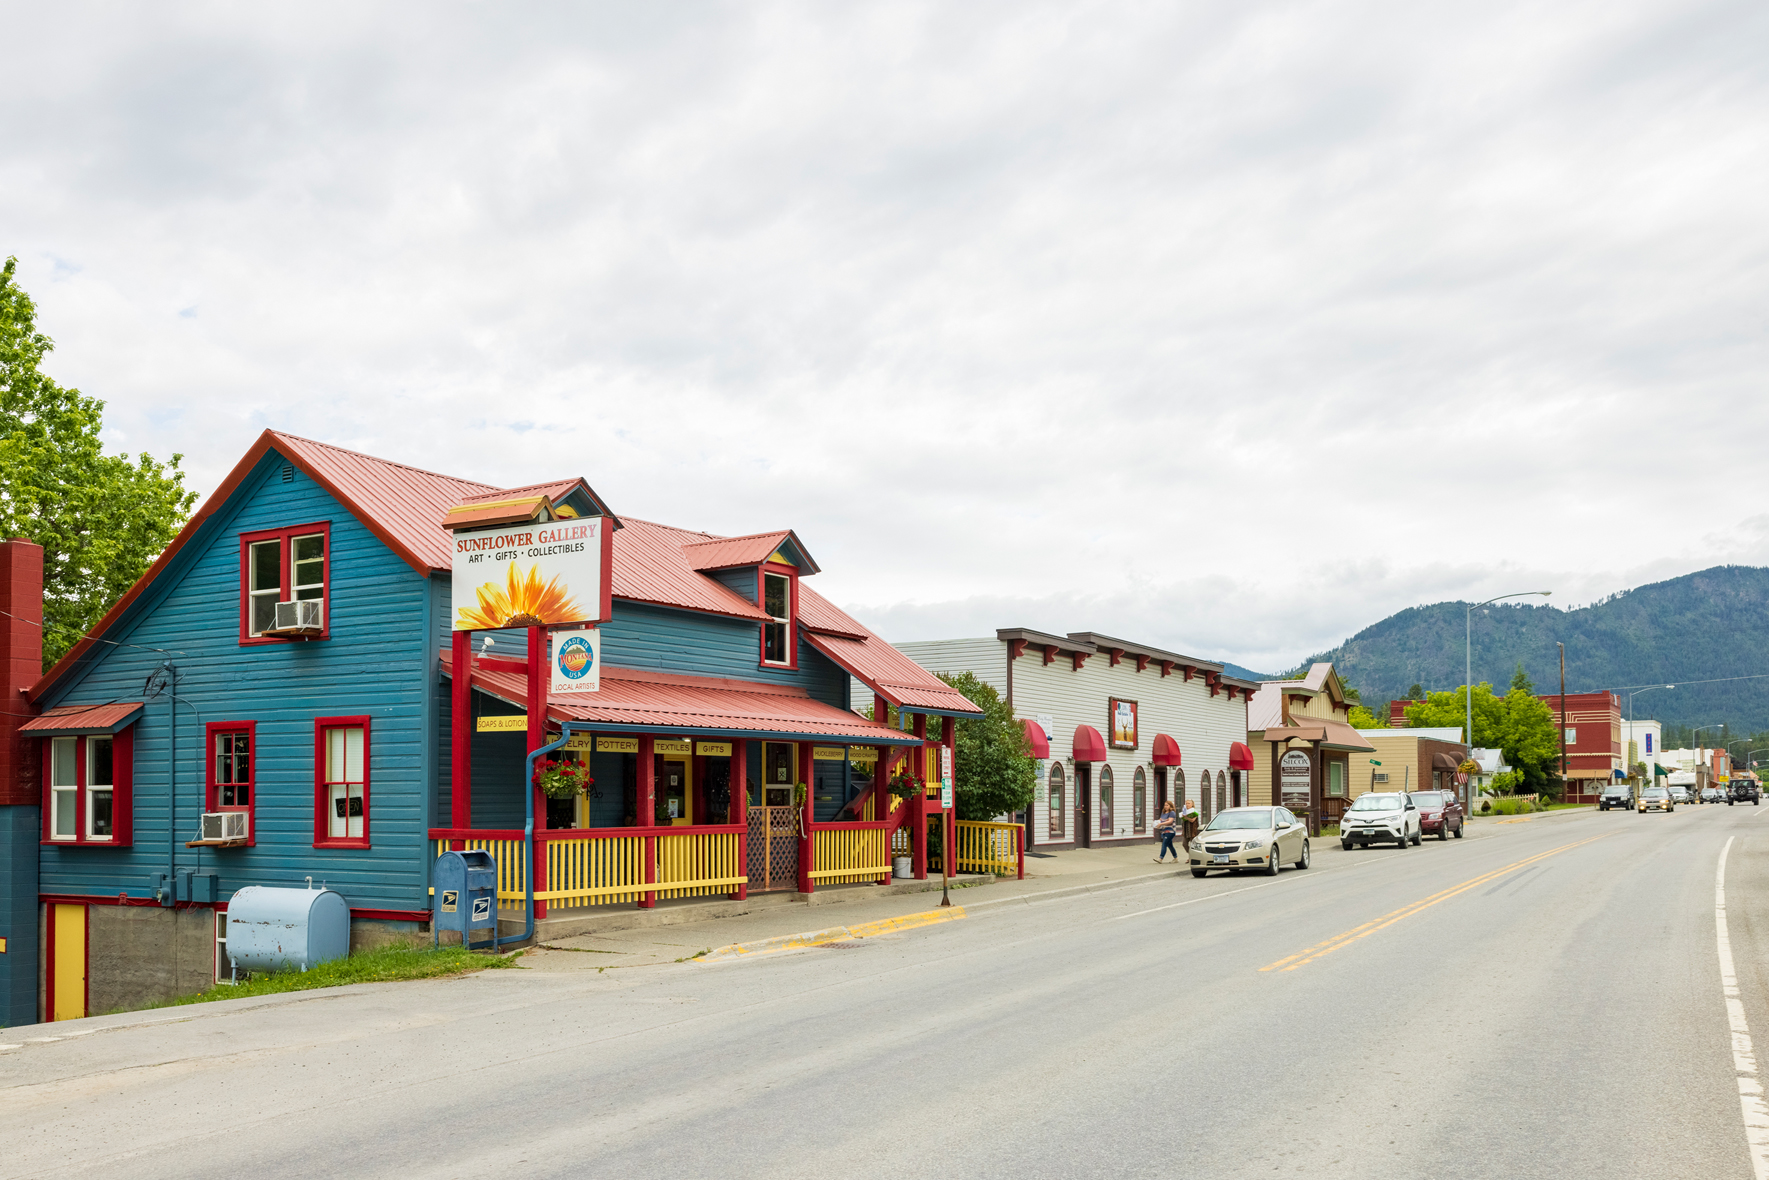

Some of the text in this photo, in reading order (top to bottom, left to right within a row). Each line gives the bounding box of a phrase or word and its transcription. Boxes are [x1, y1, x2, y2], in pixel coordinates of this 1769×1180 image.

[457, 524, 597, 552] SUNFLOWER GALLERY
[469, 542, 584, 563] ART GIFTS COLLECTIBLES
[563, 638, 590, 650] MADE IN
[559, 653, 592, 668] MONTANA
[478, 720, 496, 728] SOAPS
[504, 720, 528, 728] LOTION
[598, 740, 637, 750] POTTERY
[656, 744, 690, 752] TEXTILES
